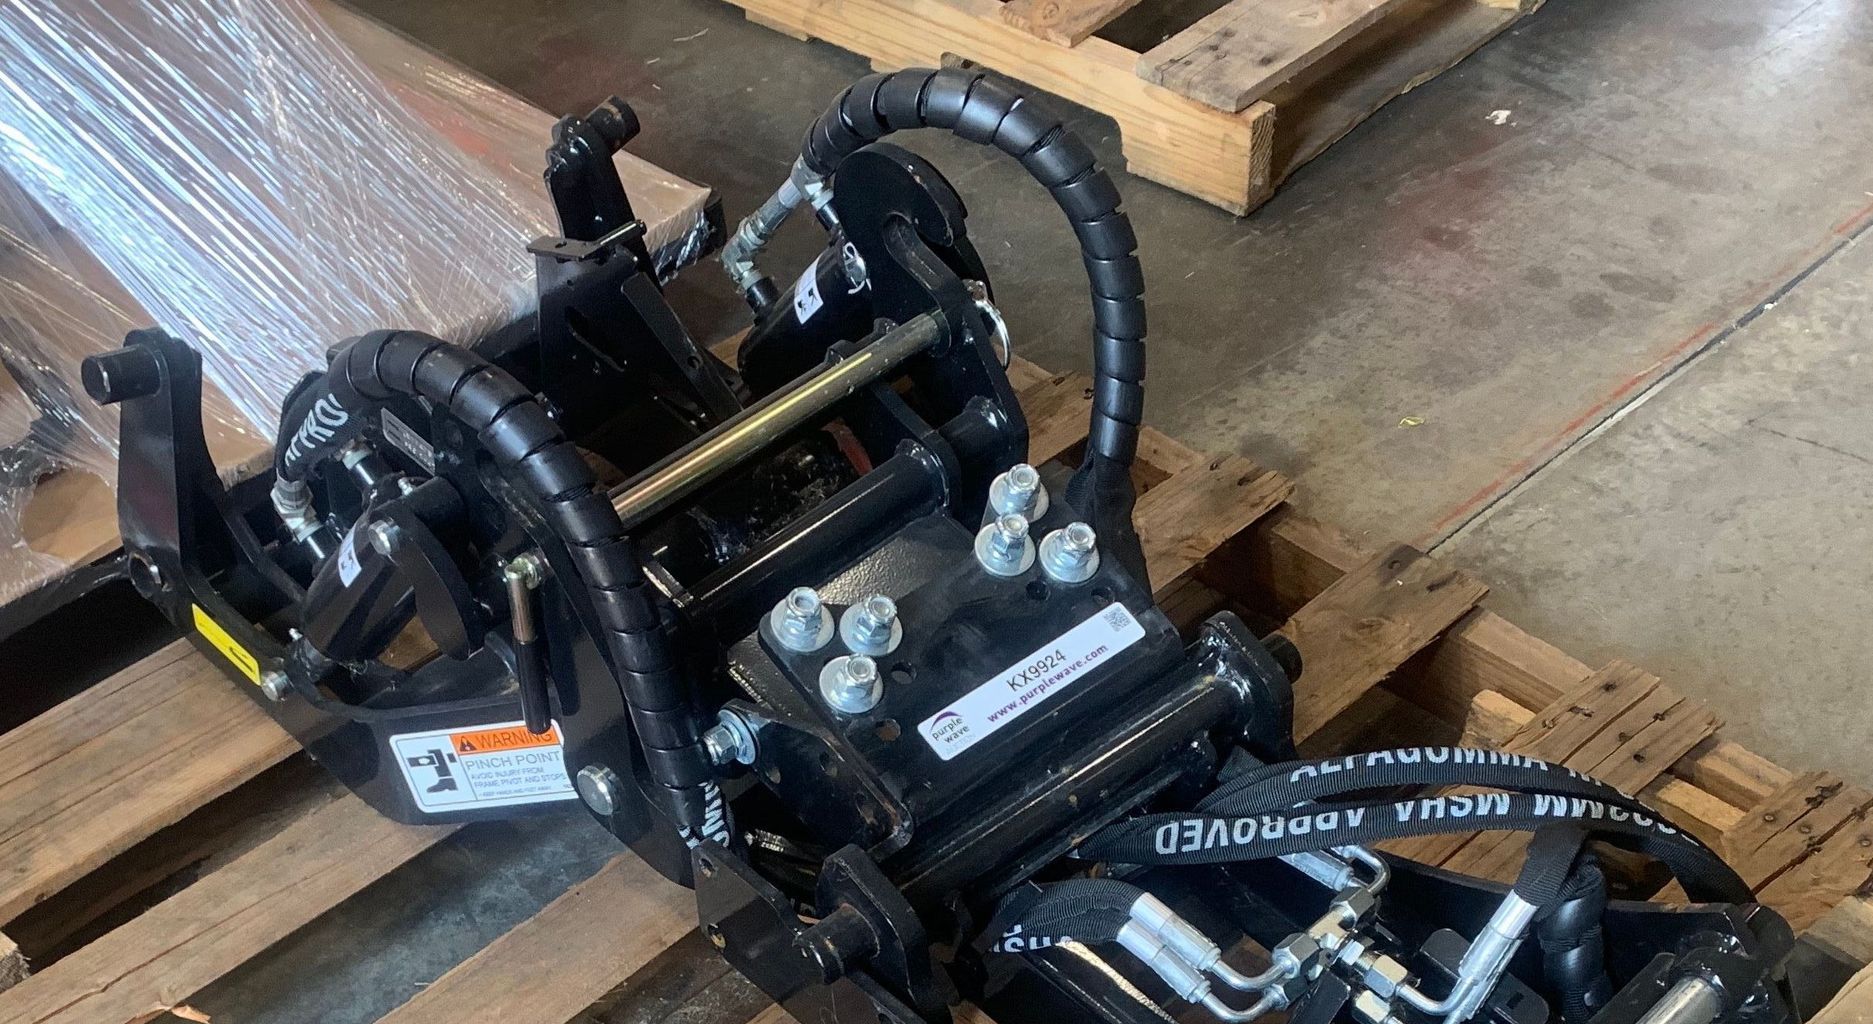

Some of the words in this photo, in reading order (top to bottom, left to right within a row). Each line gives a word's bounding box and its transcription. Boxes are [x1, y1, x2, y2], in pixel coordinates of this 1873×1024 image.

[987, 644, 1109, 723] www.purplewave.com
[1006, 649, 1066, 692] KX9924
[932, 716, 963, 741] purple
[944, 725, 970, 744] wave
[465, 755, 513, 771] PINCH
[514, 750, 561, 766] POINT
[1155, 808, 1366, 855] APPROVED
